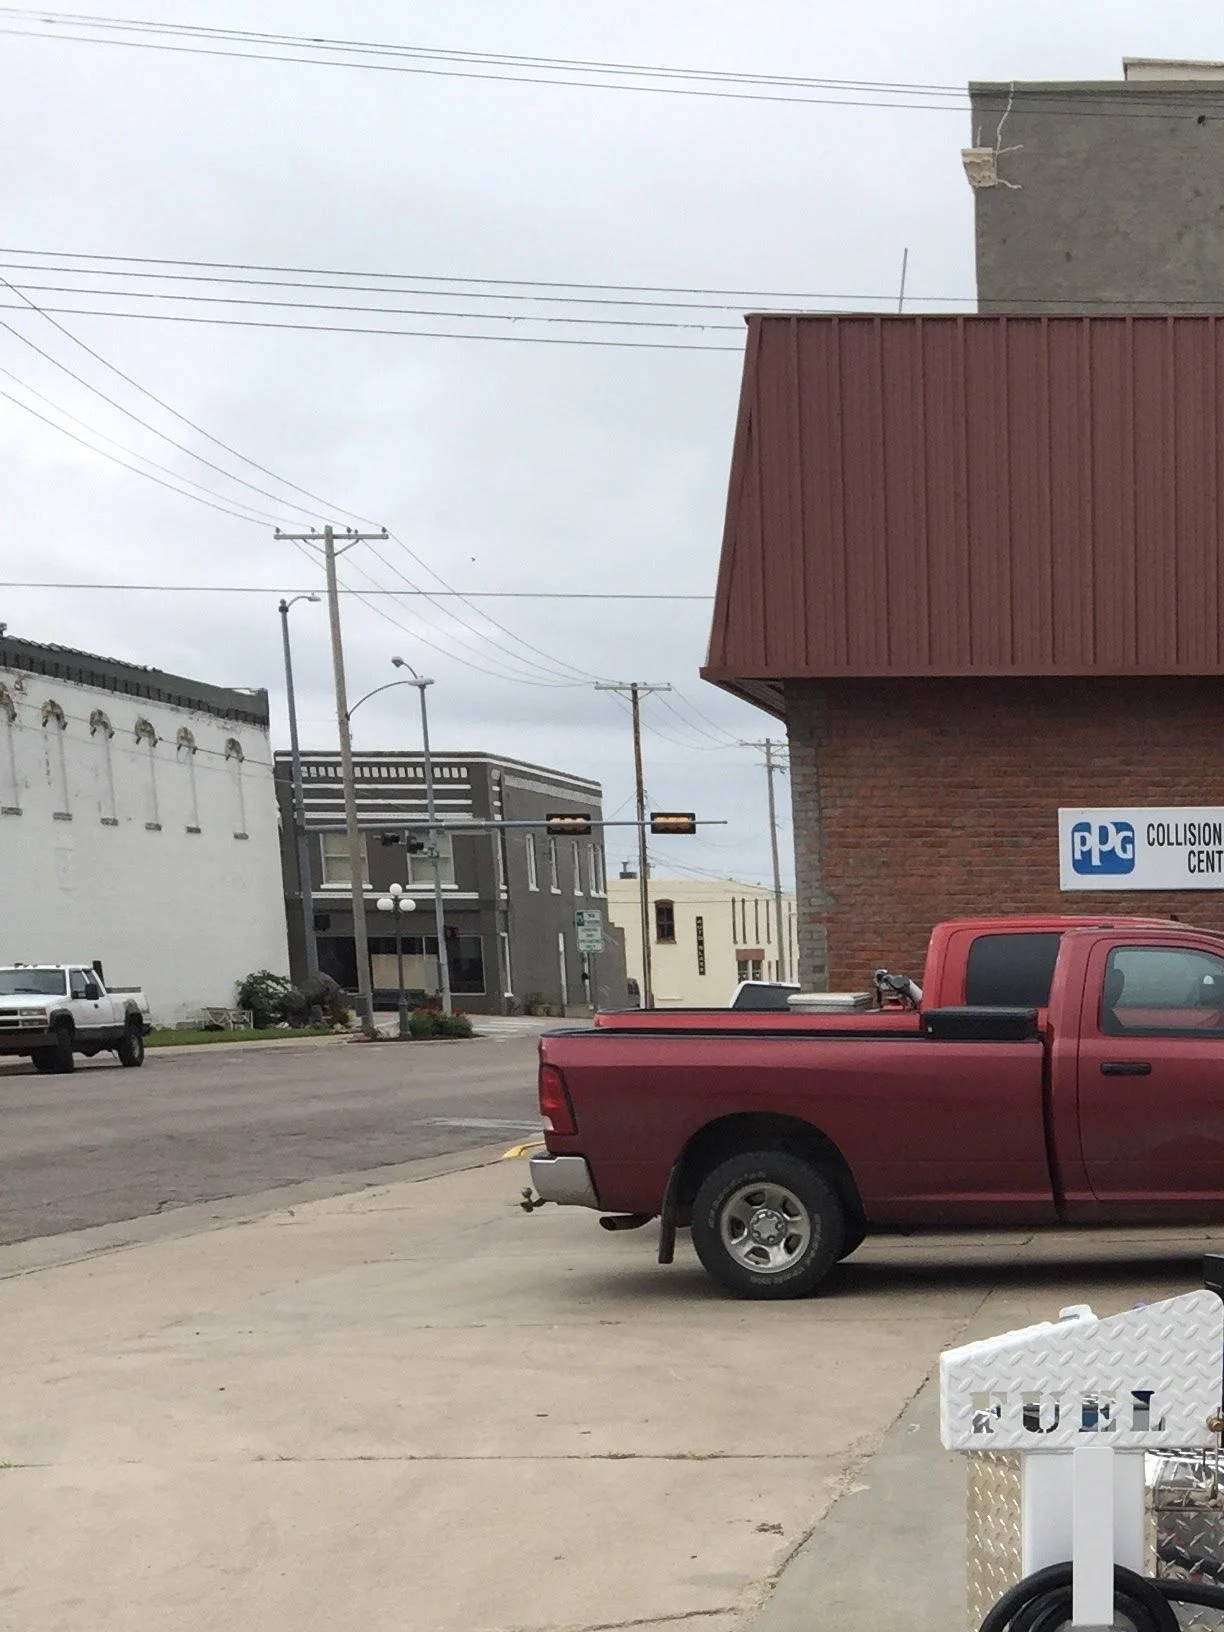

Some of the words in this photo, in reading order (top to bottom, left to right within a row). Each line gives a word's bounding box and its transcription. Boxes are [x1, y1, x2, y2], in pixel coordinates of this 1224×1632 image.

[1073, 821, 1133, 866] PPG
[1146, 822, 1222, 847] COLLISION
[969, 1390, 1168, 1434] FUEL
